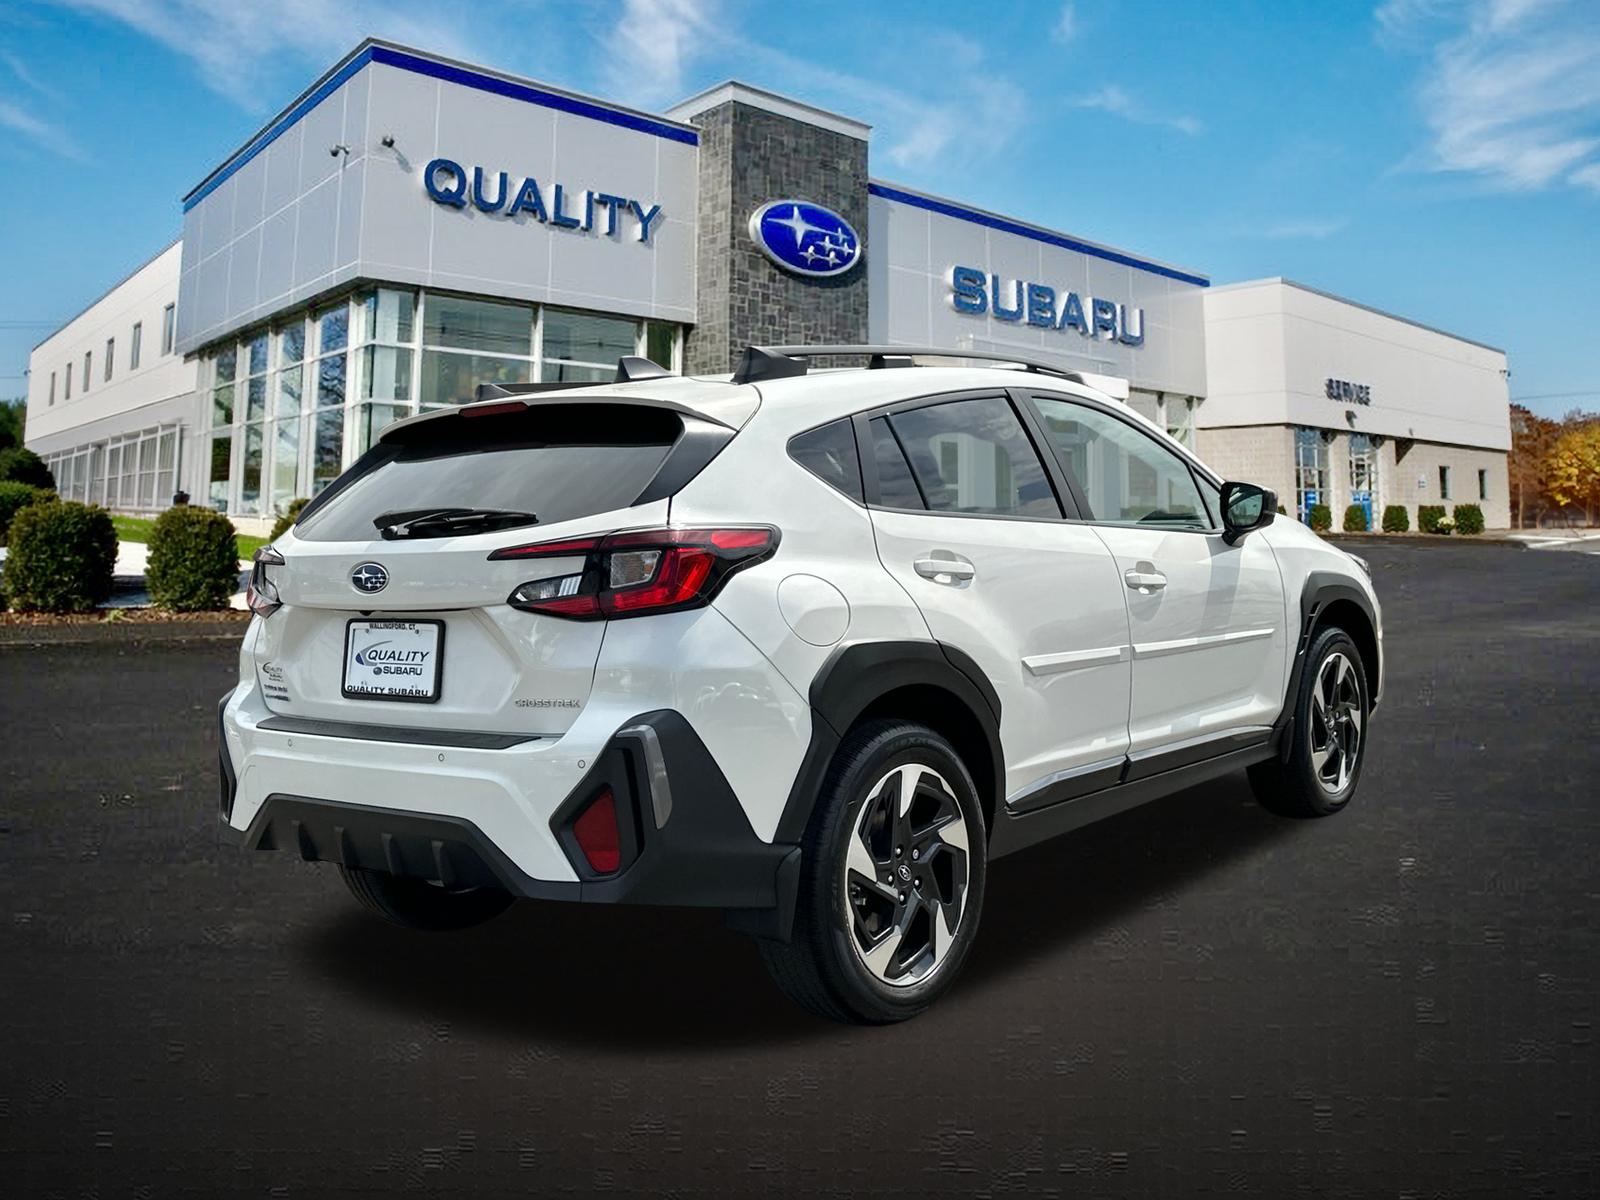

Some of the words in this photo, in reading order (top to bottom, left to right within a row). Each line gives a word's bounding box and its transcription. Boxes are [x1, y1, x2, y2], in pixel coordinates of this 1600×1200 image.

[424, 158, 661, 242] QUALITY
[948, 265, 1145, 347] SUBARU
[1325, 378, 1370, 406] SERVICE
[368, 650, 429, 662] QUALITY
[383, 666, 423, 676] SUBARU
[347, 685, 385, 694] QUALITY
[388, 687, 428, 696] SUBARU
[515, 699, 580, 708] CROSSTREK
